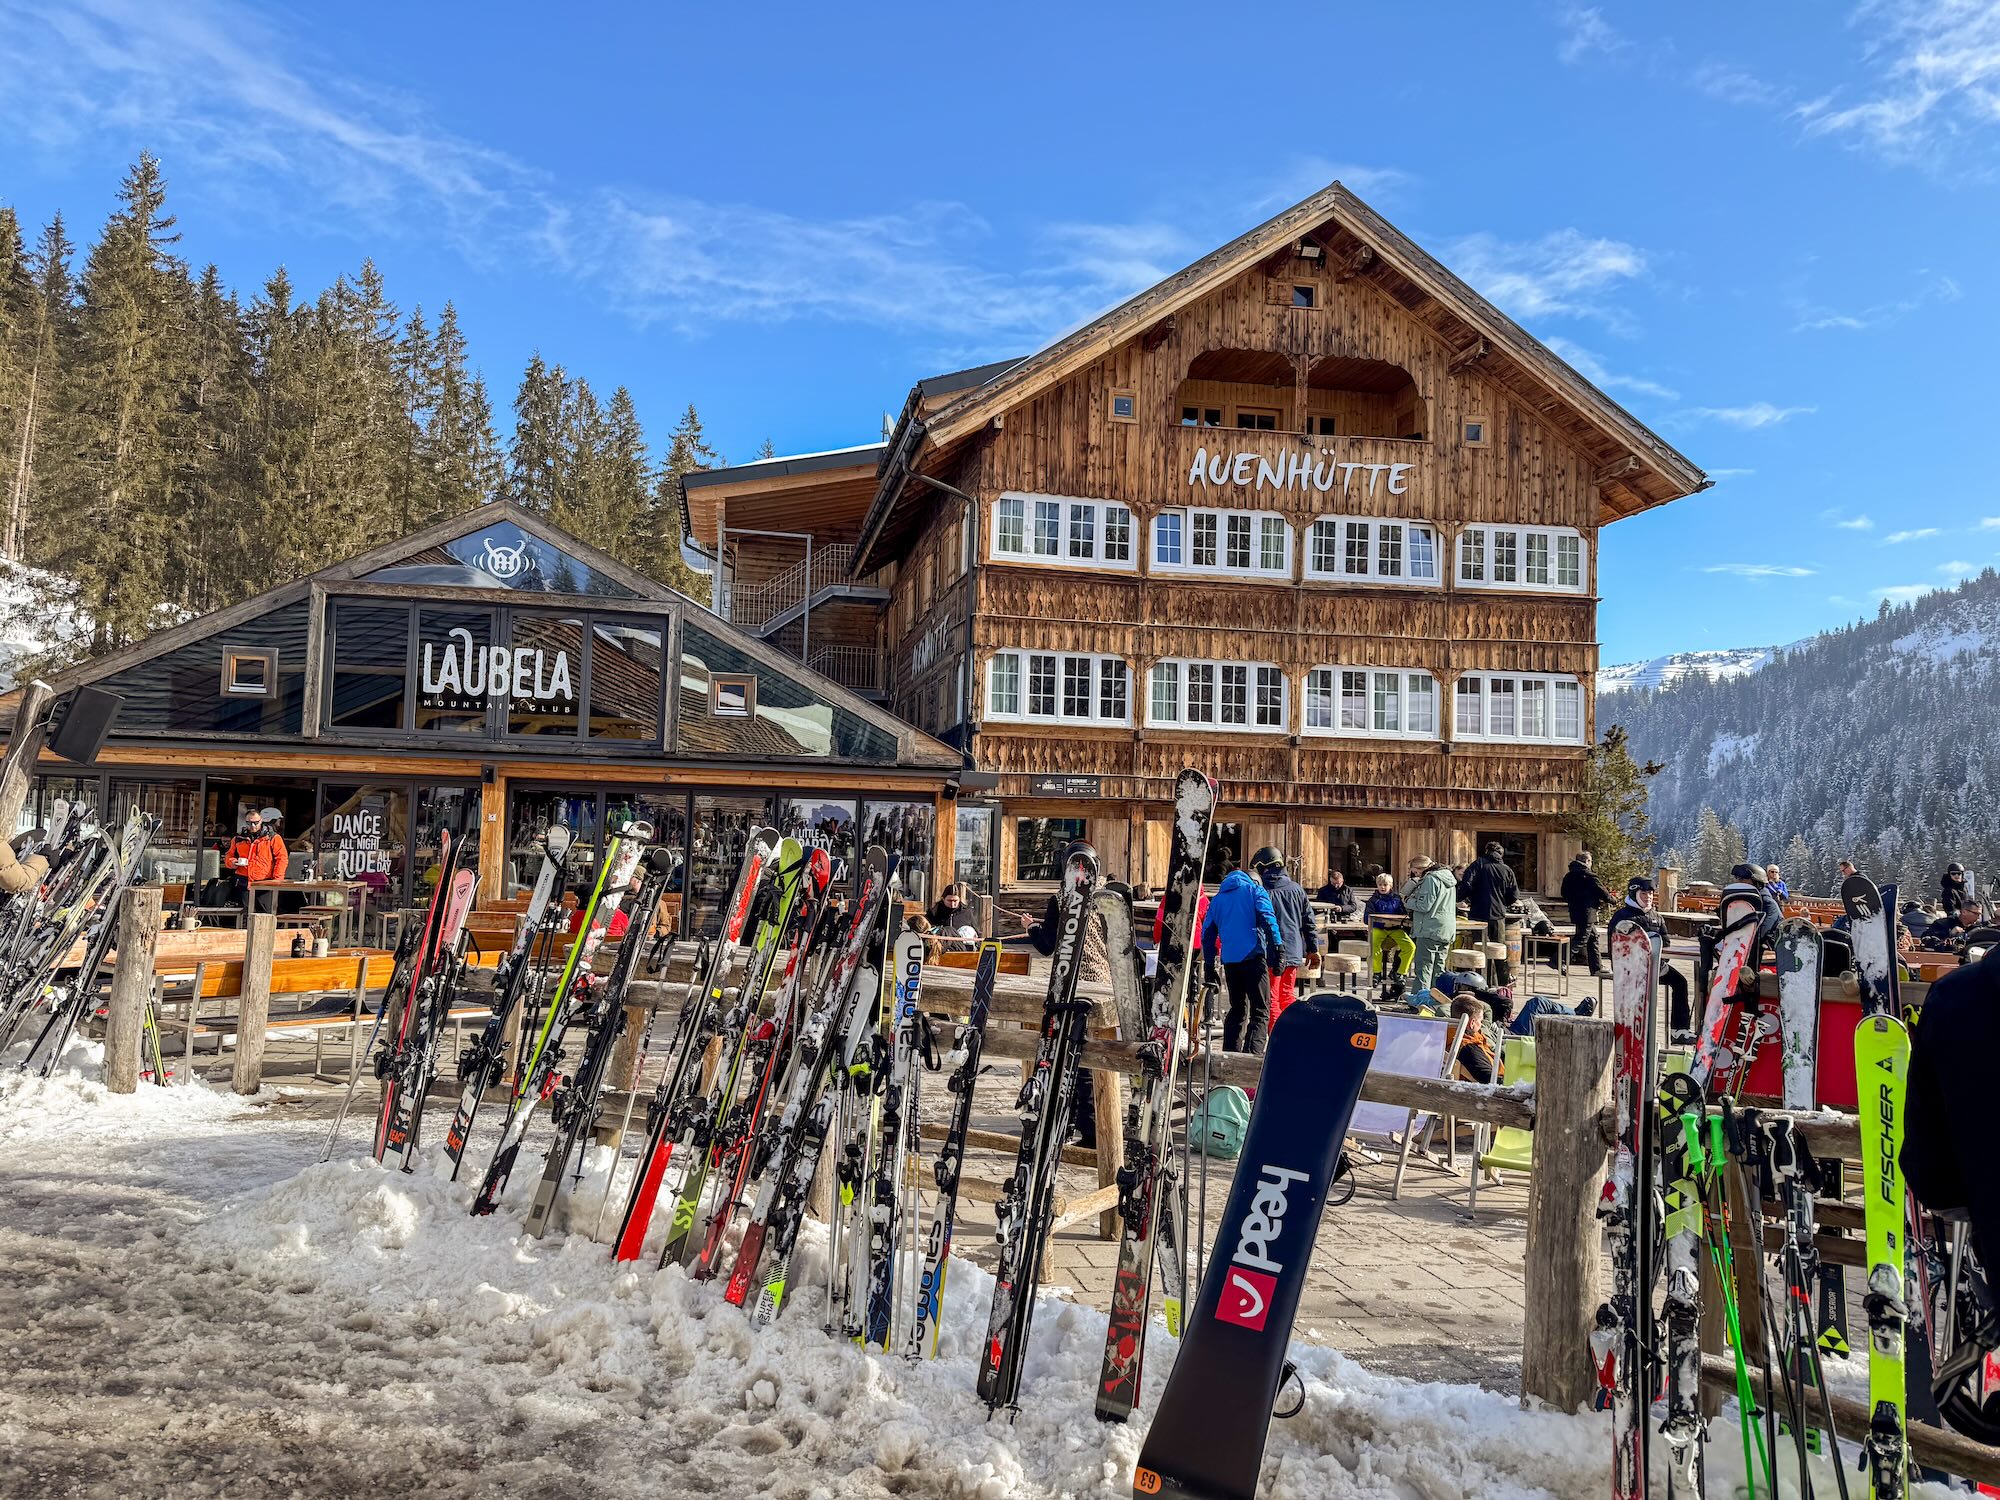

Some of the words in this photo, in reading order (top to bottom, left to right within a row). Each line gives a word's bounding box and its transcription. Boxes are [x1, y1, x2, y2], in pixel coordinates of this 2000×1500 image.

[1188, 447, 1416, 497] AUENHÜTTE
[422, 628, 573, 700] LAUBELA
[423, 699, 515, 711] MOUNTAIN
[529, 703, 571, 713] CLUB
[333, 809, 381, 839] DANCE
[790, 829, 796, 838] A
[798, 828, 820, 838] LITTLE
[340, 838, 354, 850] ALL
[356, 834, 381, 850] NIGHT
[338, 850, 377, 878] RIDE
[378, 852, 390, 862] ALL
[376, 862, 392, 875] DAY
[1056, 890, 1084, 977] ATOMIC
[1355, 1035, 1371, 1048] 63
[1880, 1083, 1895, 1206] FISCHER
[674, 1196, 698, 1230] SX
[1232, 1164, 1310, 1274] head
[758, 1289, 772, 1320] SUPER
[763, 1290, 778, 1322] SHAPE
[1140, 1472, 1157, 1490] 63
